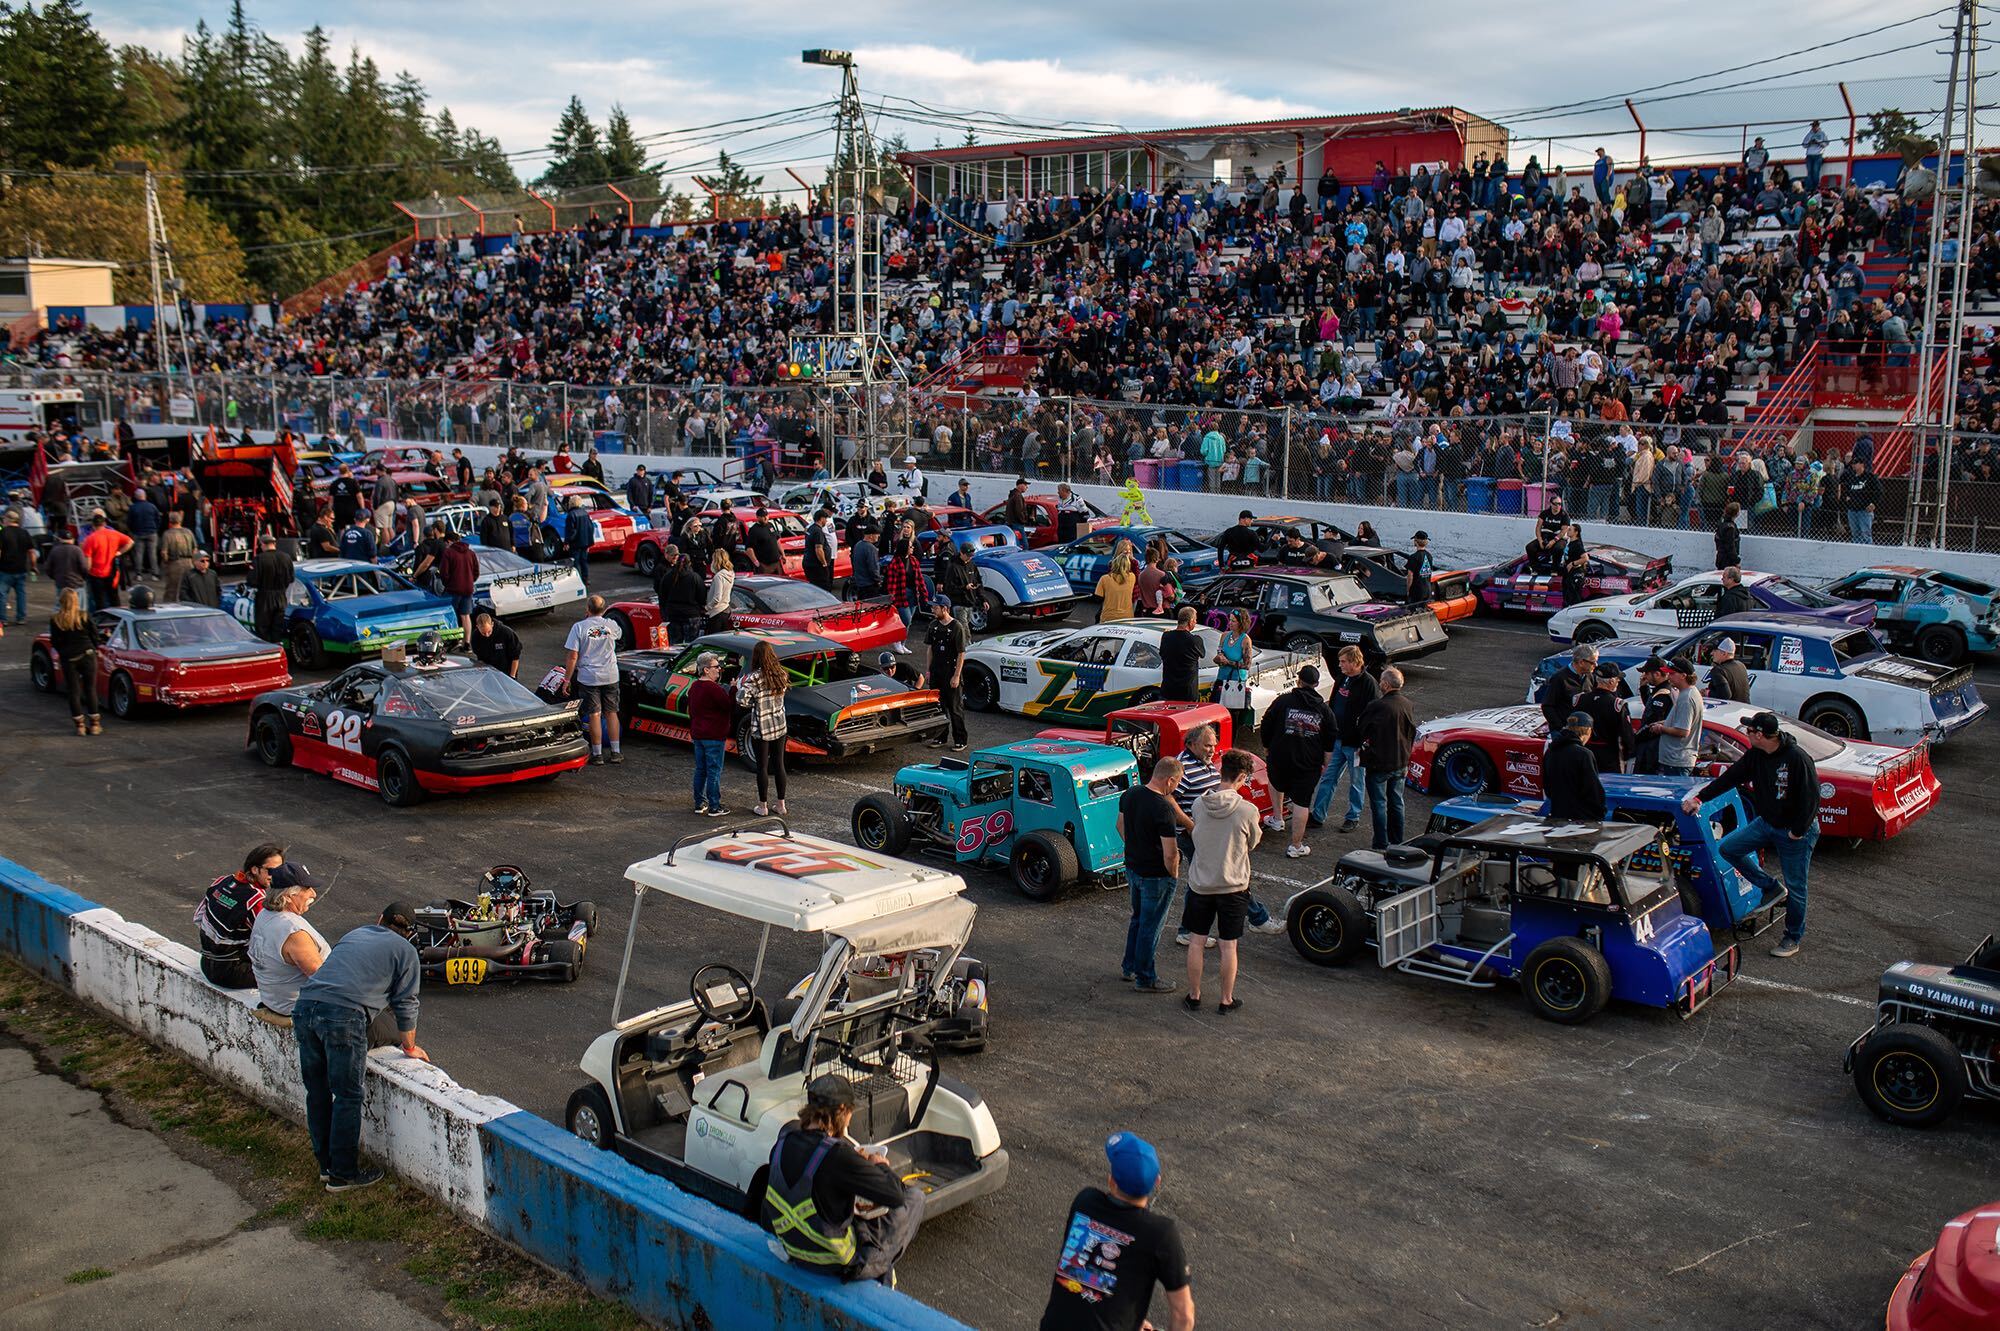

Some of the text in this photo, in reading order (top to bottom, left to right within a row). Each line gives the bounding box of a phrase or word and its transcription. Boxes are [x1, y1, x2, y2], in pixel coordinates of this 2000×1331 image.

[1065, 555, 1098, 582] 47
[760, 618, 785, 626] CIDERY
[1634, 610, 1646, 618] 15
[1784, 659, 1804, 667] MSD
[1036, 659, 1110, 715] 77
[457, 715, 476, 725] 22
[326, 710, 363, 755] 22
[1901, 786, 1925, 807] THE KEG
[1818, 807, 1848, 816] ovincial
[1821, 815, 1836, 824] Ltd.
[955, 810, 1014, 853] 59
[1499, 821, 1600, 838] 44
[1635, 913, 1656, 944] 44
[452, 959, 479, 982] 399
[1927, 989, 1975, 1011] YAMAHA
[1980, 1003, 1995, 1016] R1
